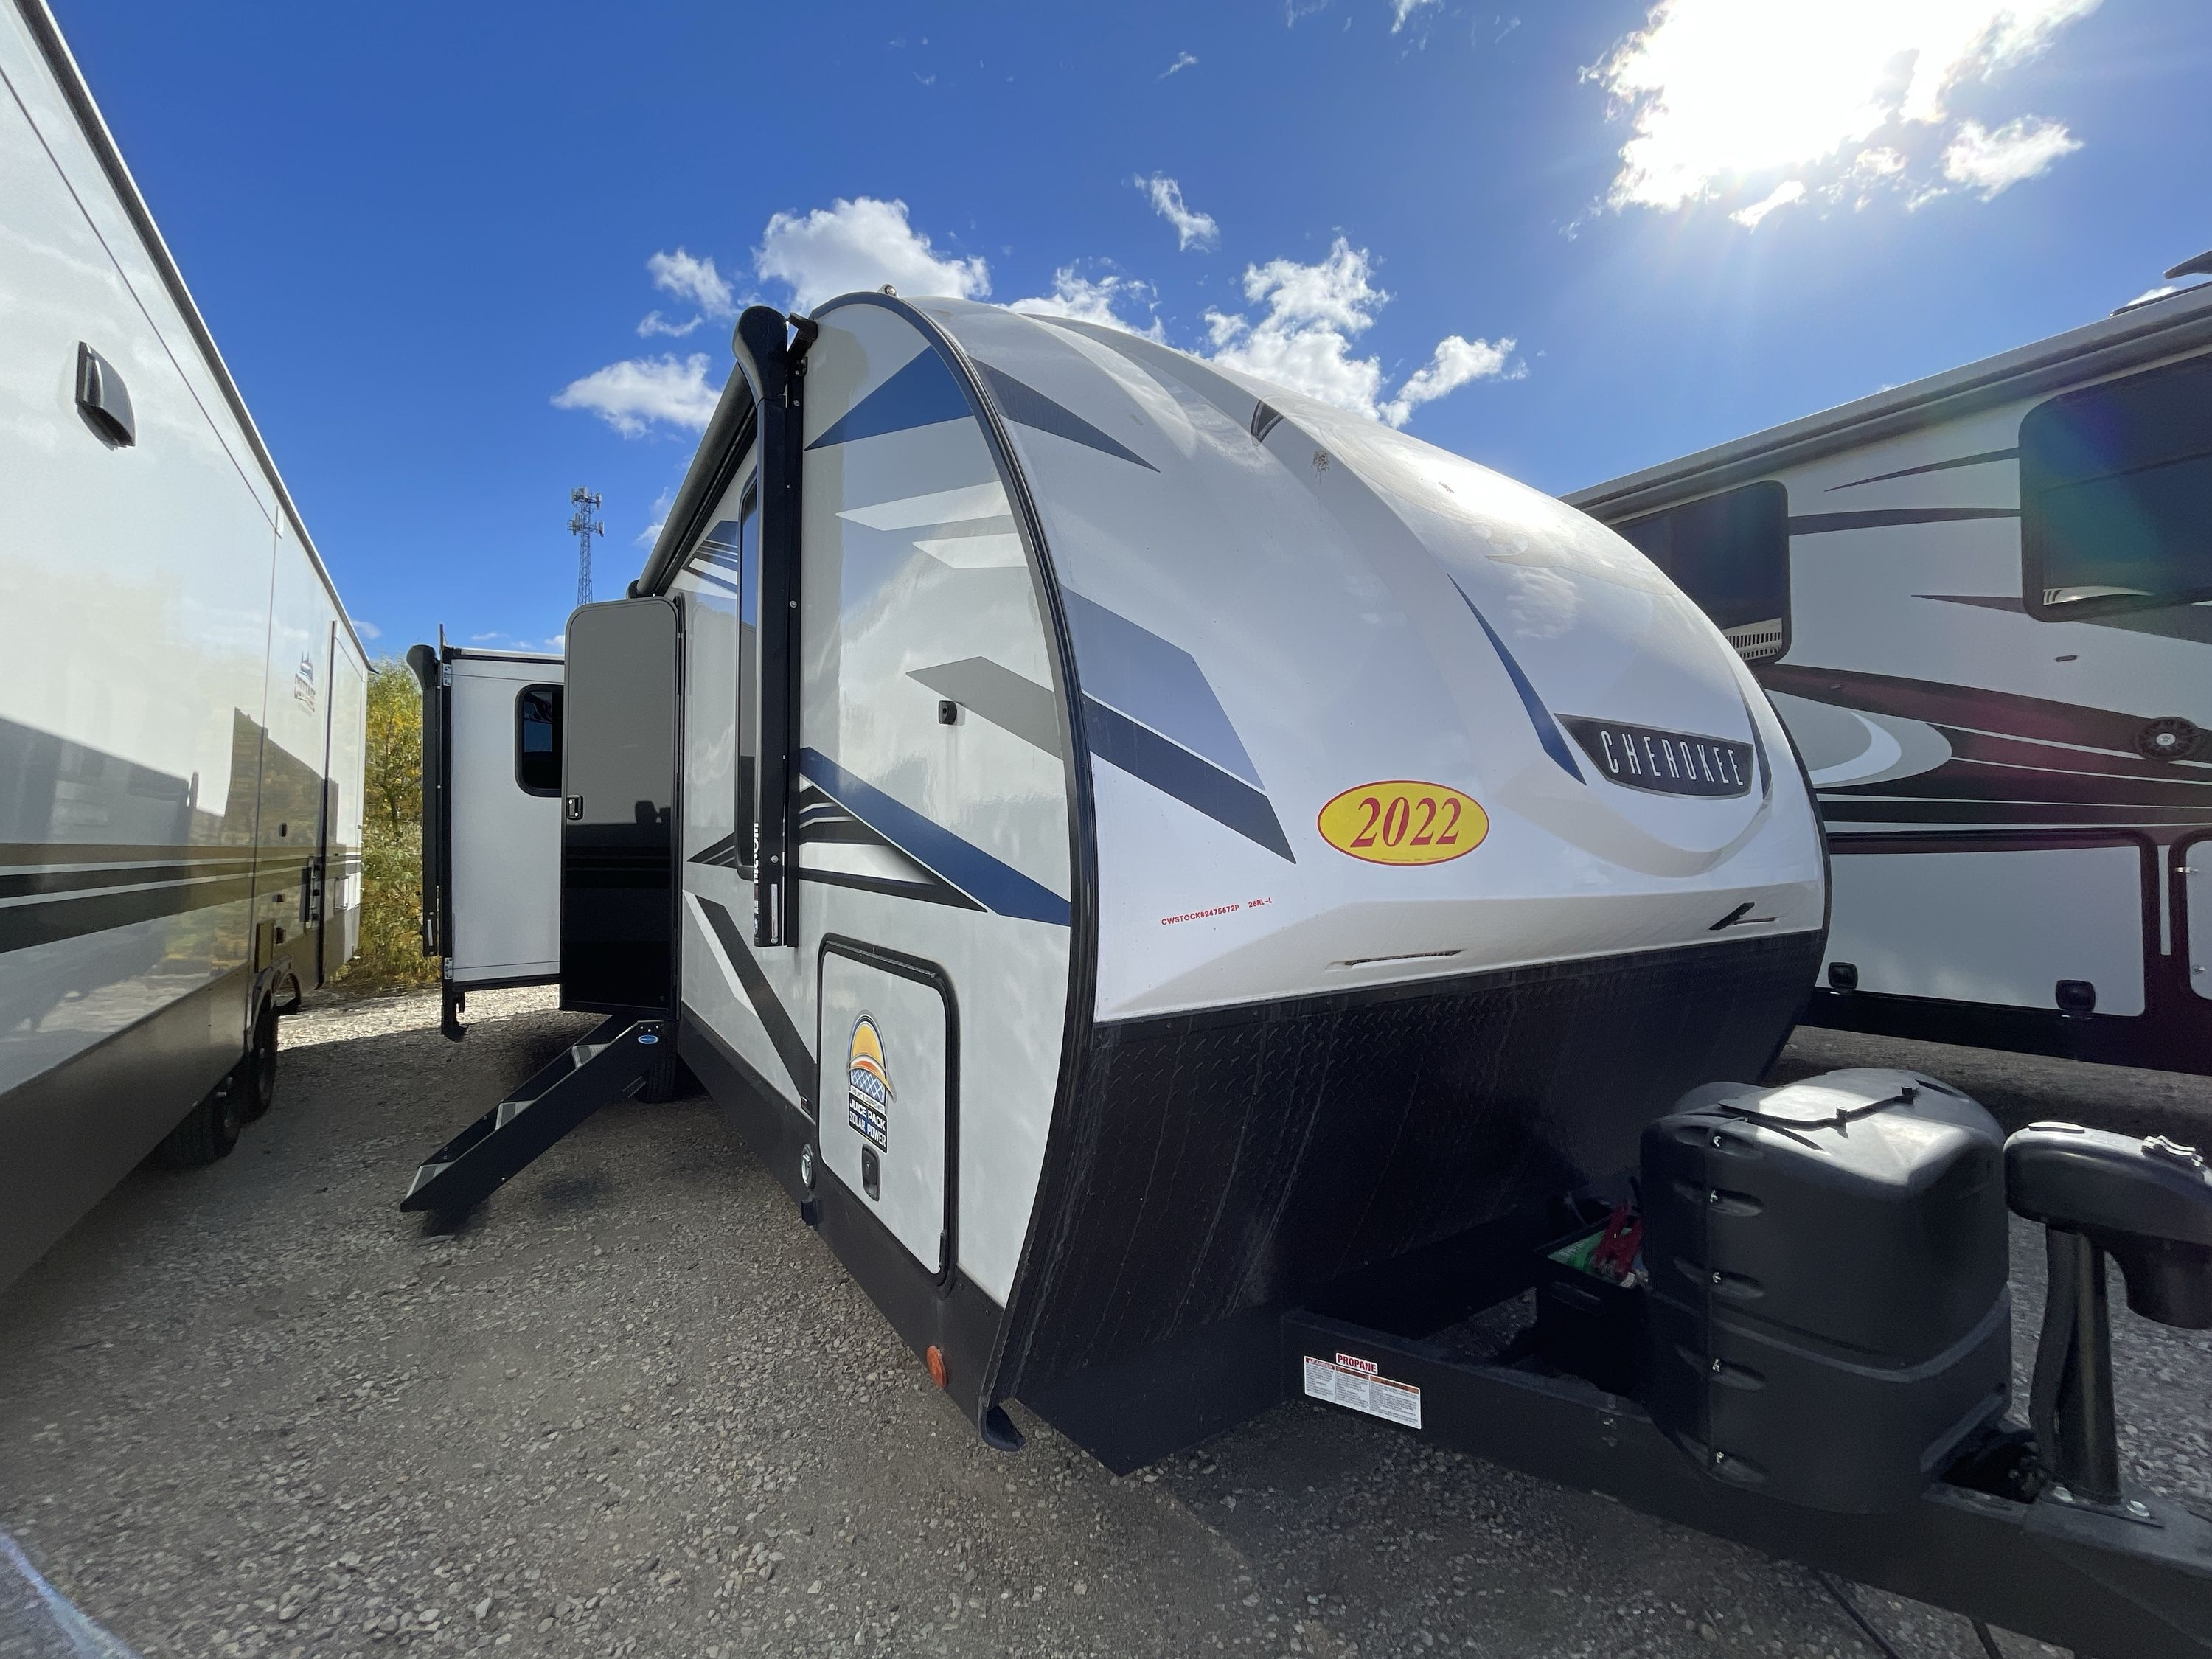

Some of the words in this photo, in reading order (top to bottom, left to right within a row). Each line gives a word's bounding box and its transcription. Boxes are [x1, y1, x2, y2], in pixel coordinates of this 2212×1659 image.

[1601, 731, 1744, 785] CHEROKEE
[1350, 796, 1461, 848] 2022
[1161, 904, 1239, 925] CWSTOCK#2475672P
[1248, 897, 1273, 908] 26RL-L
[849, 1098, 866, 1117] JUICE
[867, 1109, 886, 1132] PACK
[849, 1110, 866, 1132] SOLAR
[867, 1123, 886, 1147] POWER
[1338, 1354, 1377, 1373] PROPANE
